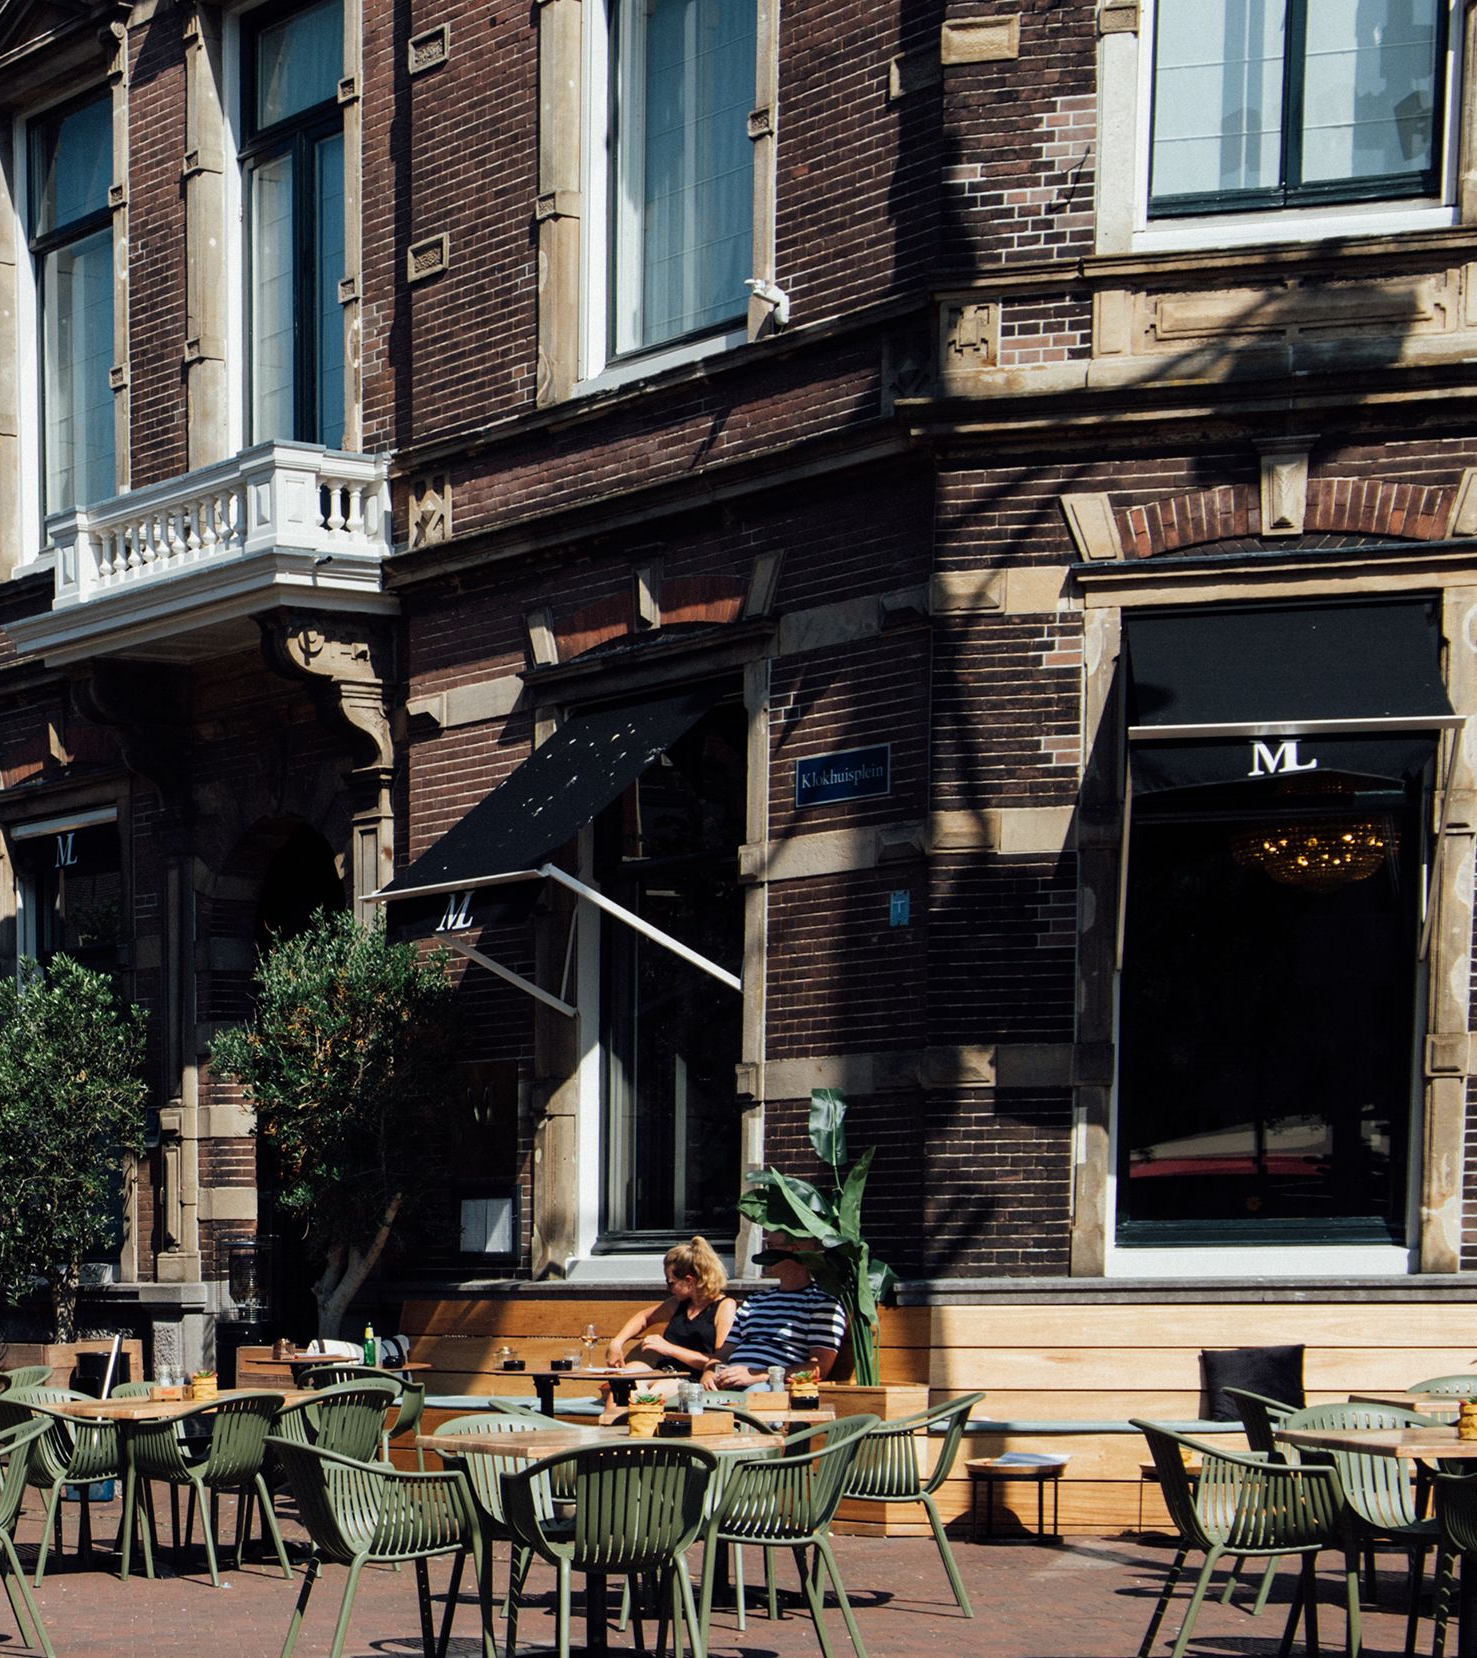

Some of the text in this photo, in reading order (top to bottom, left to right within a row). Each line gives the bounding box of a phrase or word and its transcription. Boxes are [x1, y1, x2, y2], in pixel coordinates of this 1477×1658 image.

[801, 763, 885, 789] Klokhuisplein
[1247, 738, 1318, 777] ML
[54, 832, 78, 869] ML
[435, 890, 476, 932] ML
